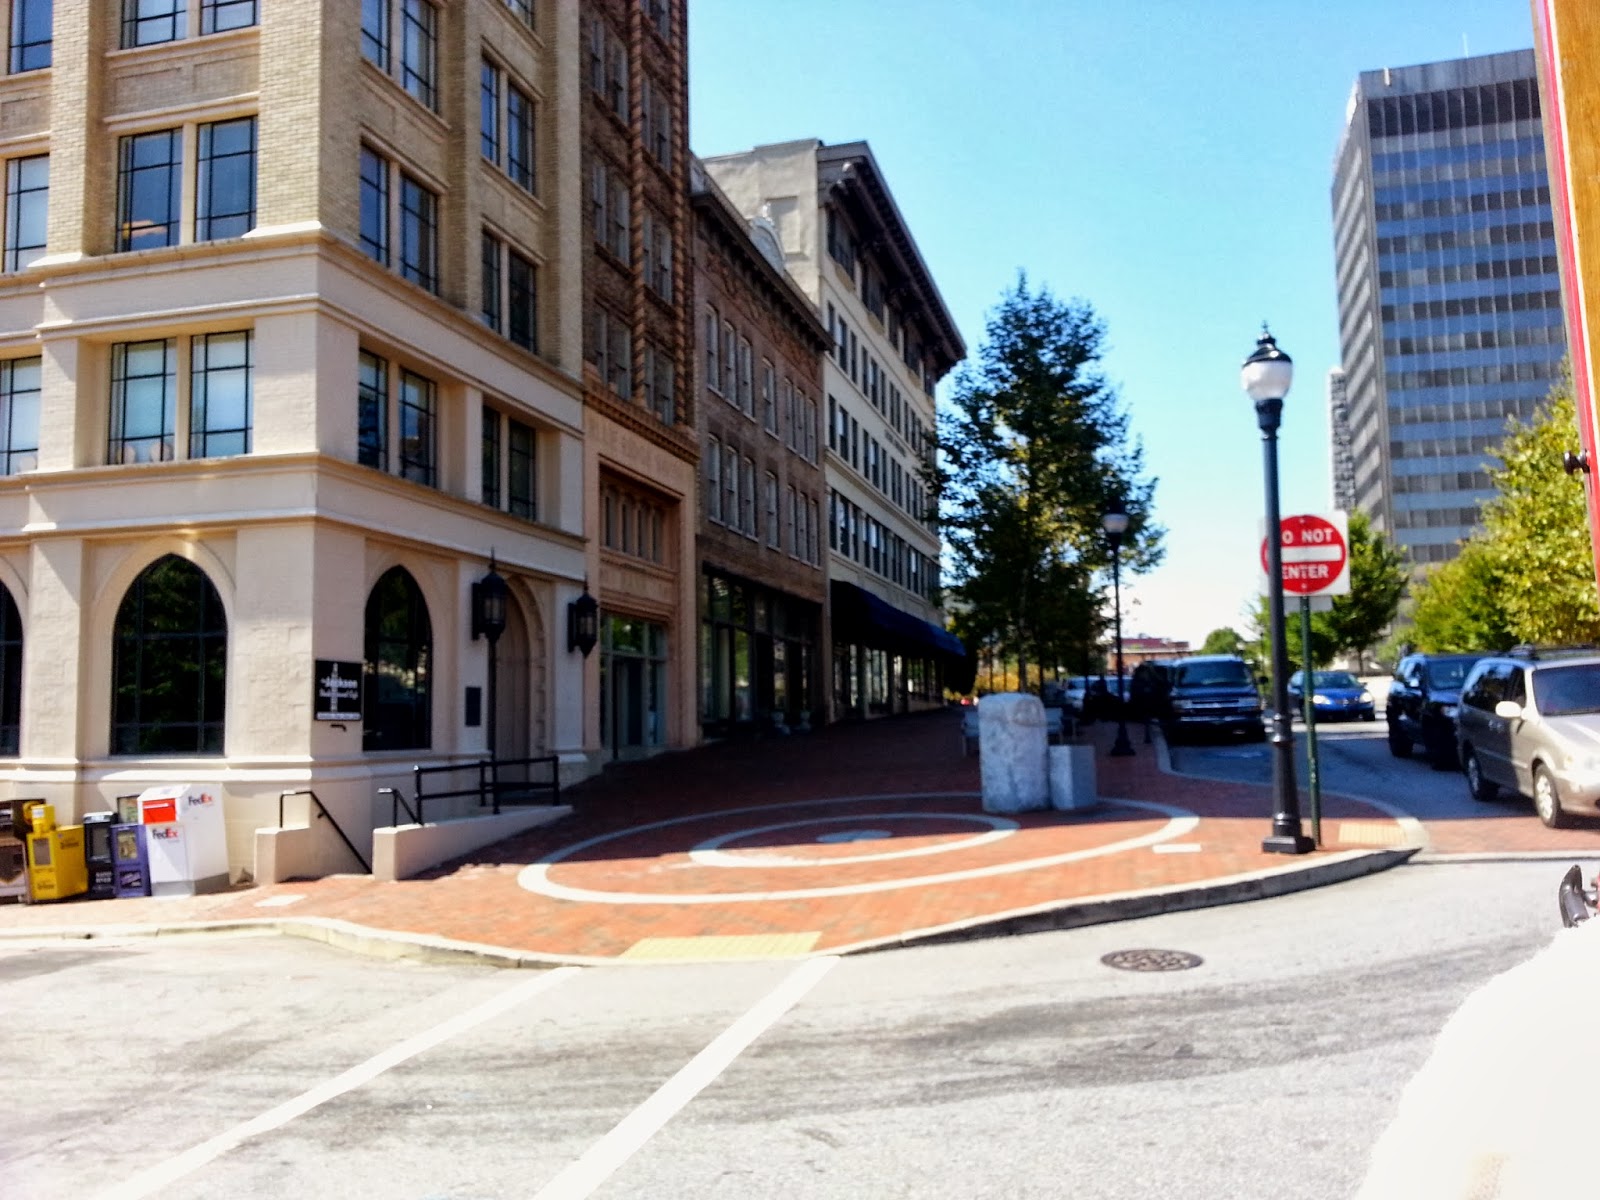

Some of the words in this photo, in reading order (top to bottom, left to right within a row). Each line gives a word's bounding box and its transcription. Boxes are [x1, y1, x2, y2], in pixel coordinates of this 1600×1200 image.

[1282, 530, 1294, 544] O
[1301, 528, 1334, 543] NOT
[188, 792, 213, 806] FedEx
[152, 826, 178, 839] FedEx
